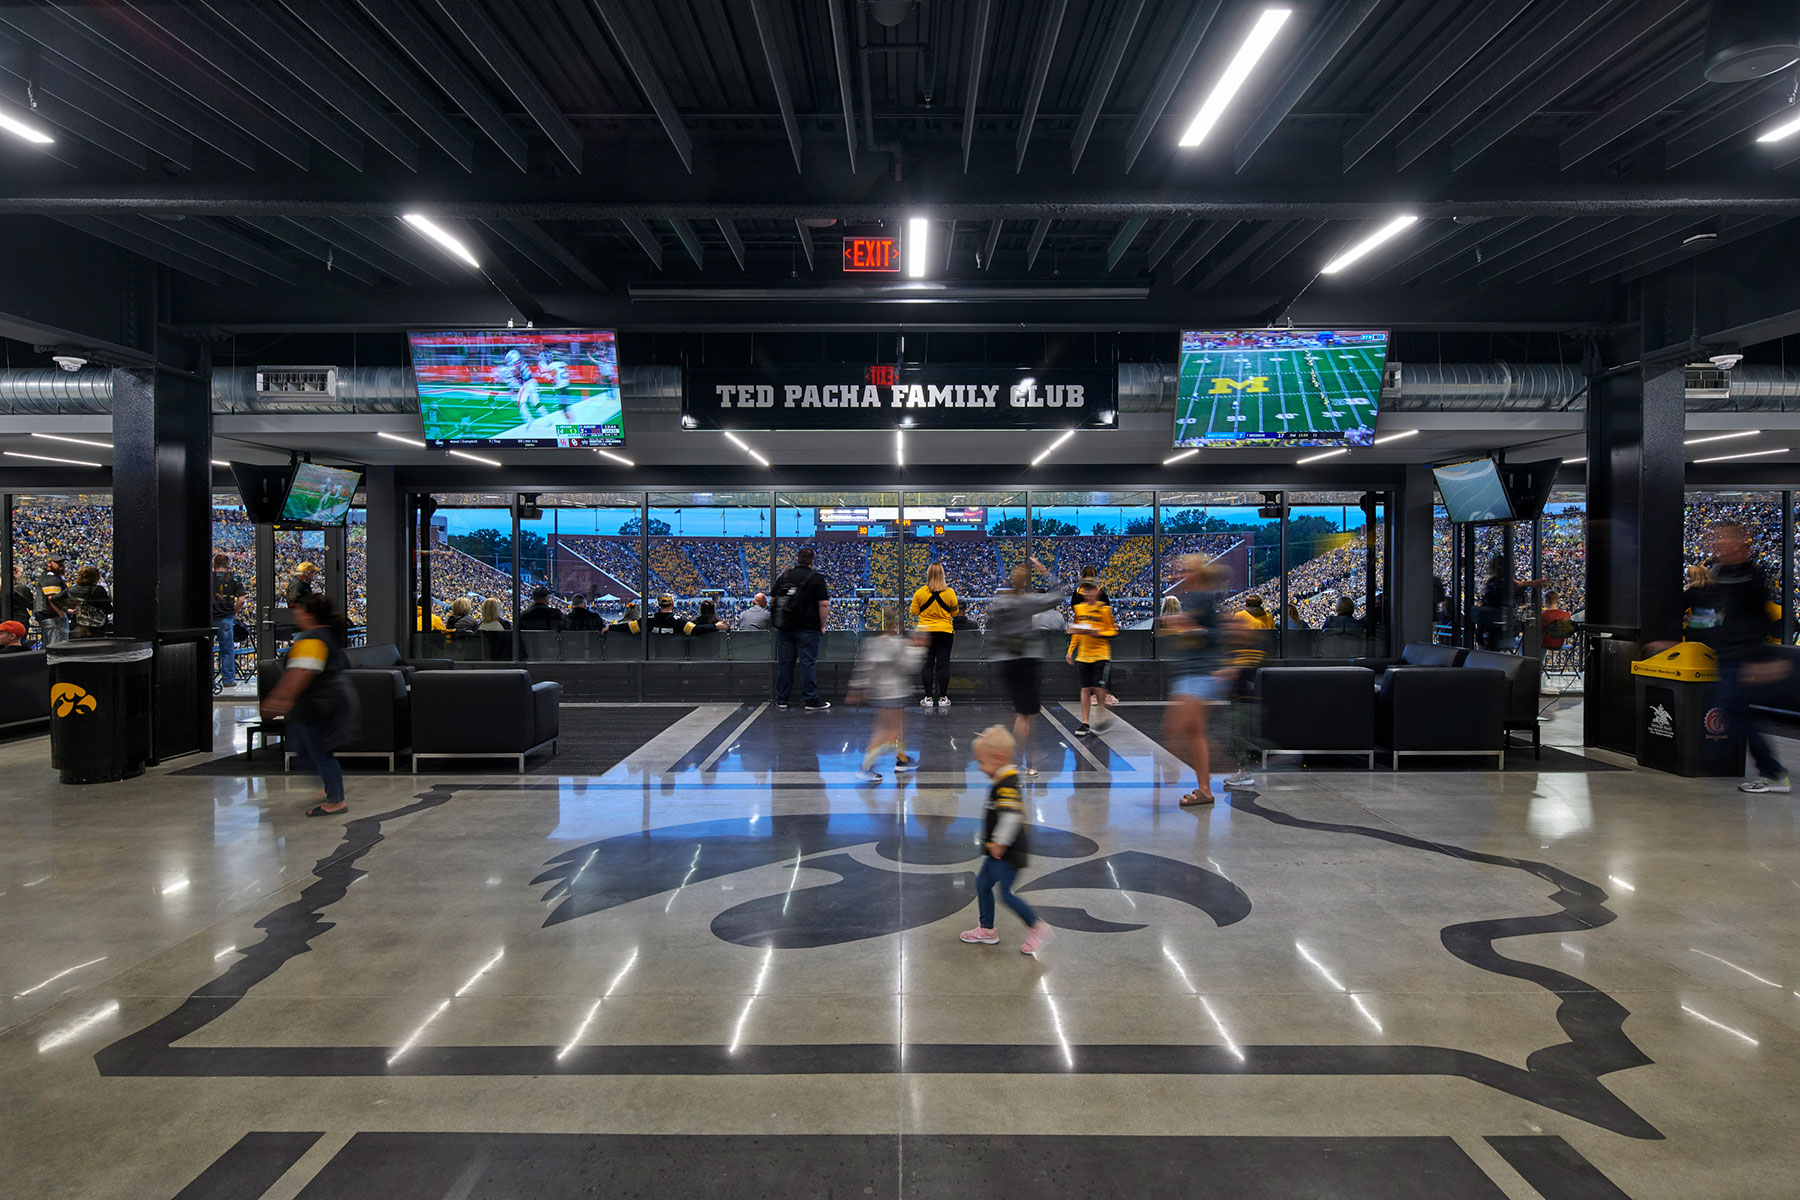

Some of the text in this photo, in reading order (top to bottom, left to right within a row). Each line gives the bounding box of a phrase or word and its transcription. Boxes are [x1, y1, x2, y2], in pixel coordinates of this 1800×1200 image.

[853, 240, 892, 267] EXIT
[1208, 376, 1270, 394] M
[716, 385, 1085, 408] TED PACHA FAMILY CLUB
[859, 526, 868, 535] 30
[935, 526, 944, 534] 30
